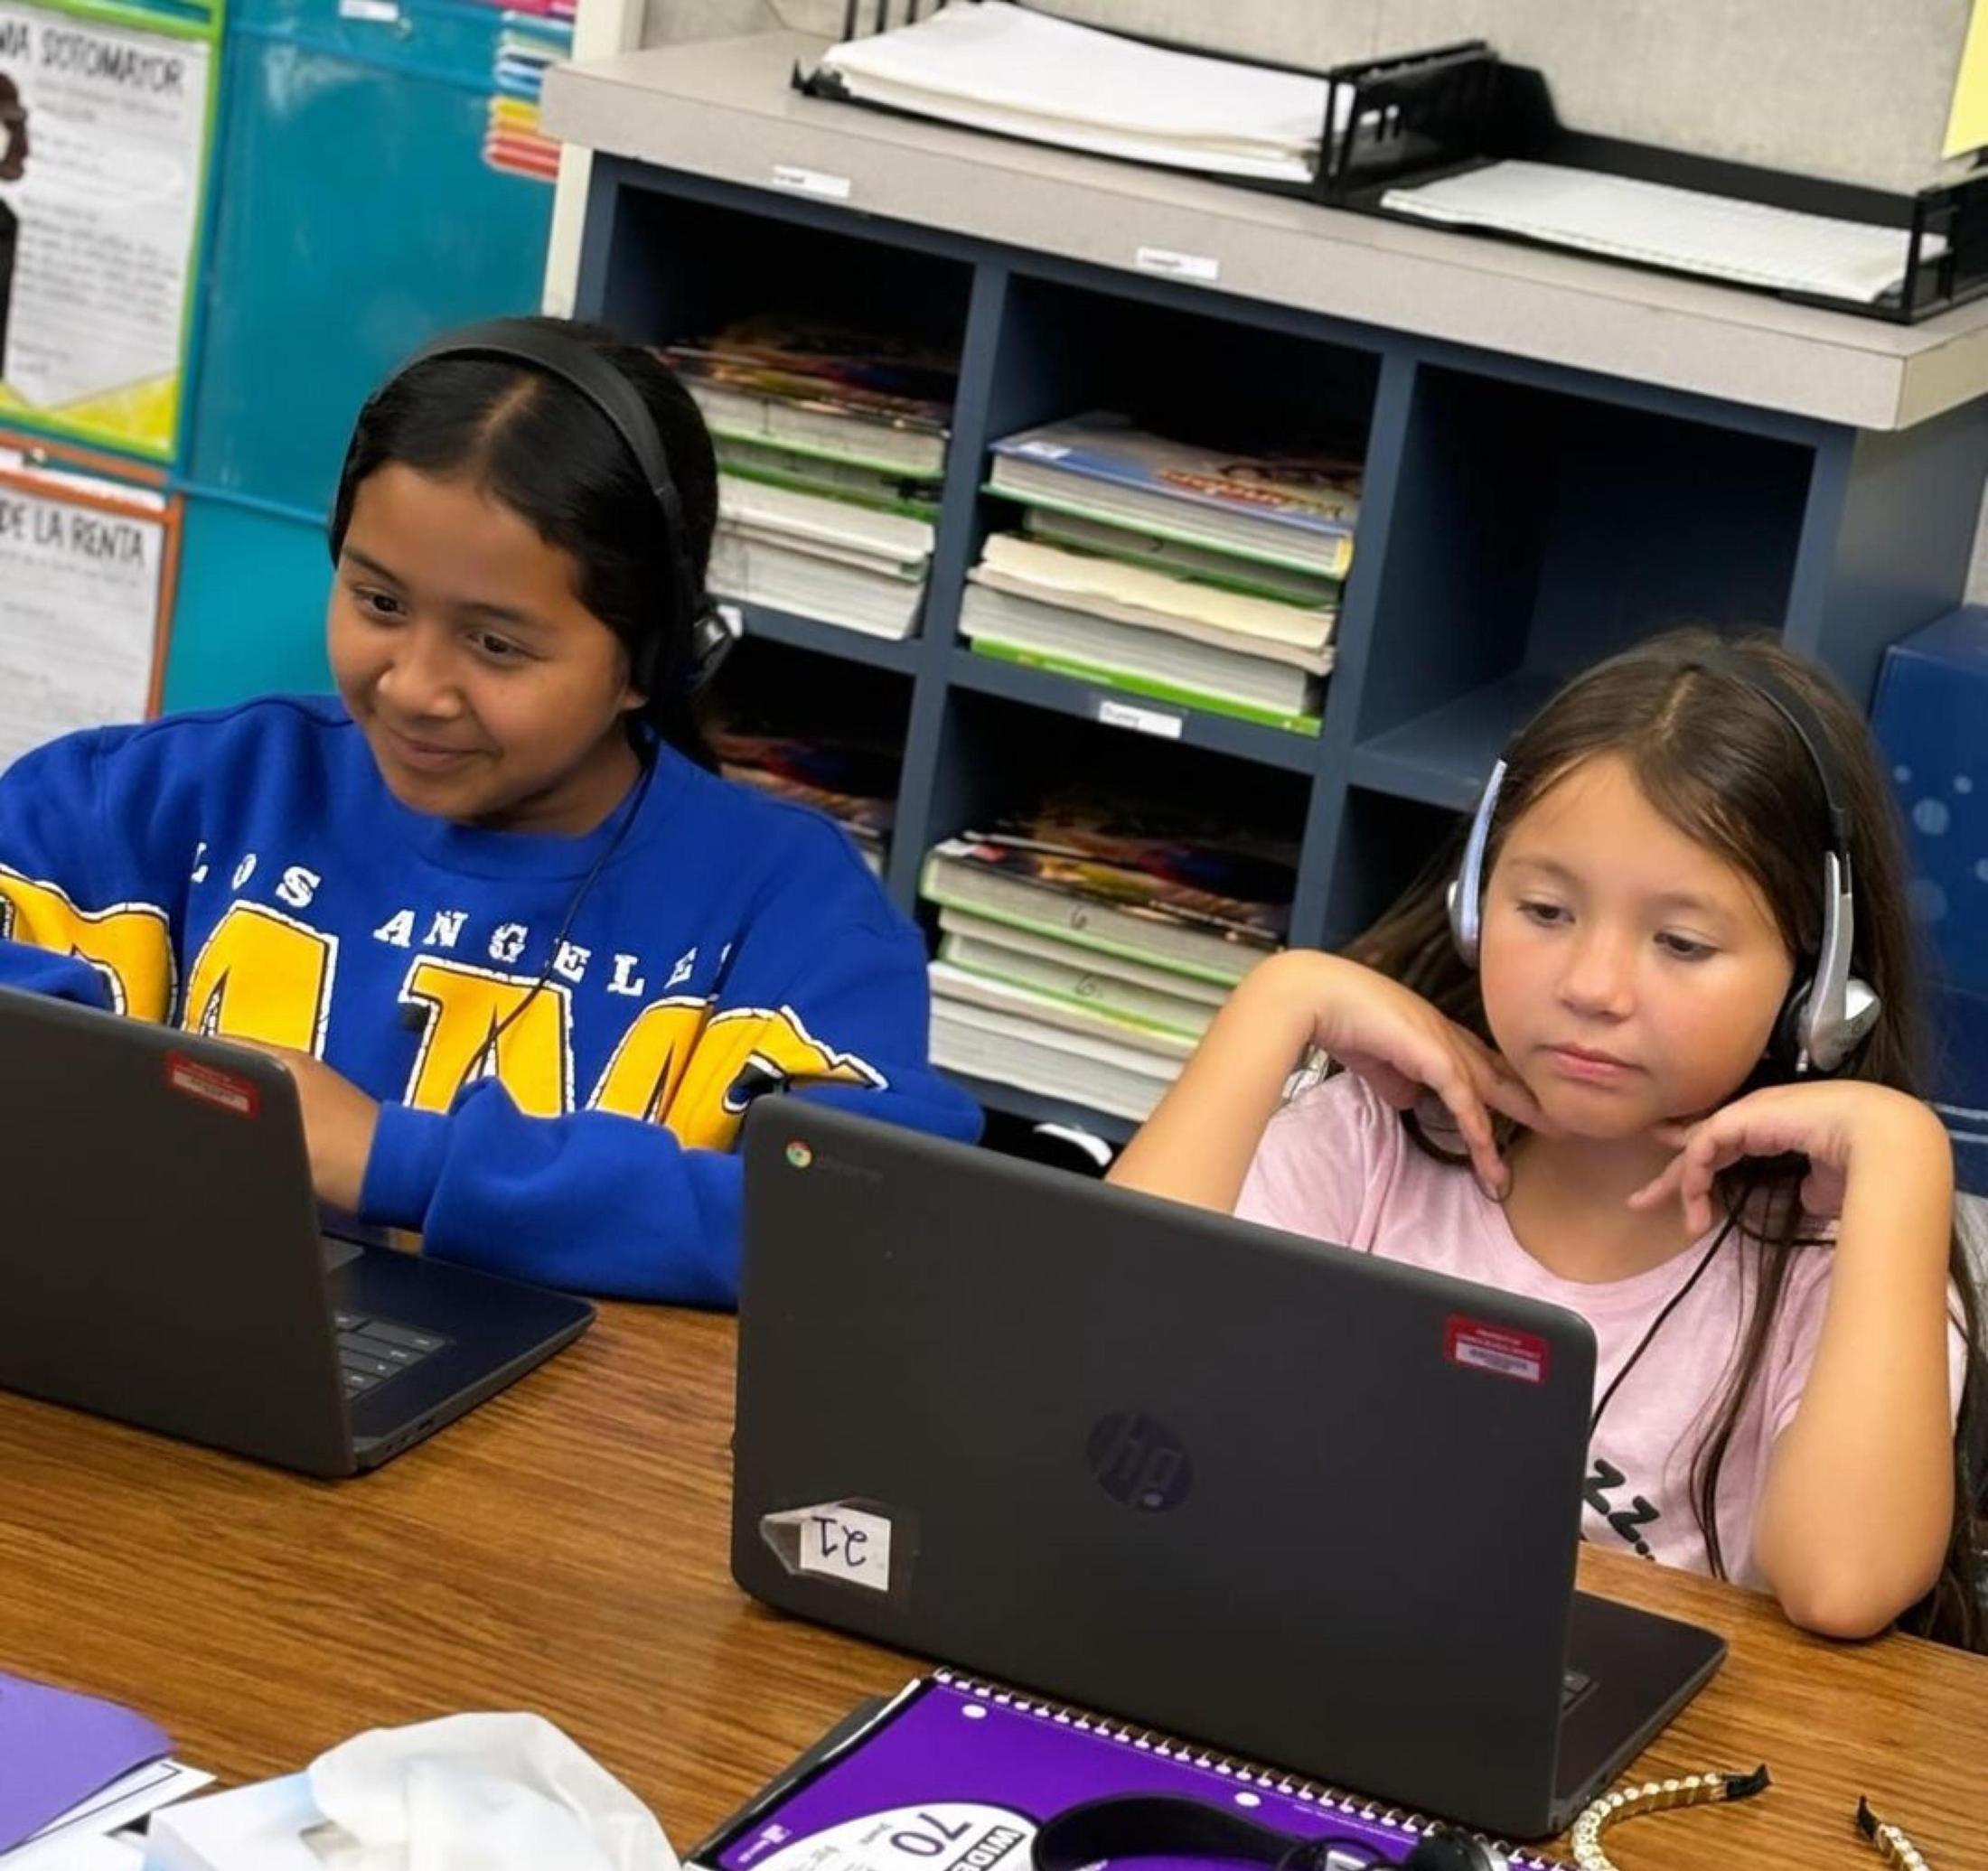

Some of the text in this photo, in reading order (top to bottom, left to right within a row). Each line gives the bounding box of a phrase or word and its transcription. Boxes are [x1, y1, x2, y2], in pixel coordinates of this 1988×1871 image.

[34, 507, 64, 547] LA
[71, 515, 145, 569] RENTA
[191, 842, 732, 996] LOS ANGELE
[1090, 1411, 1186, 1511] hp
[890, 1811, 973, 1857] 70
